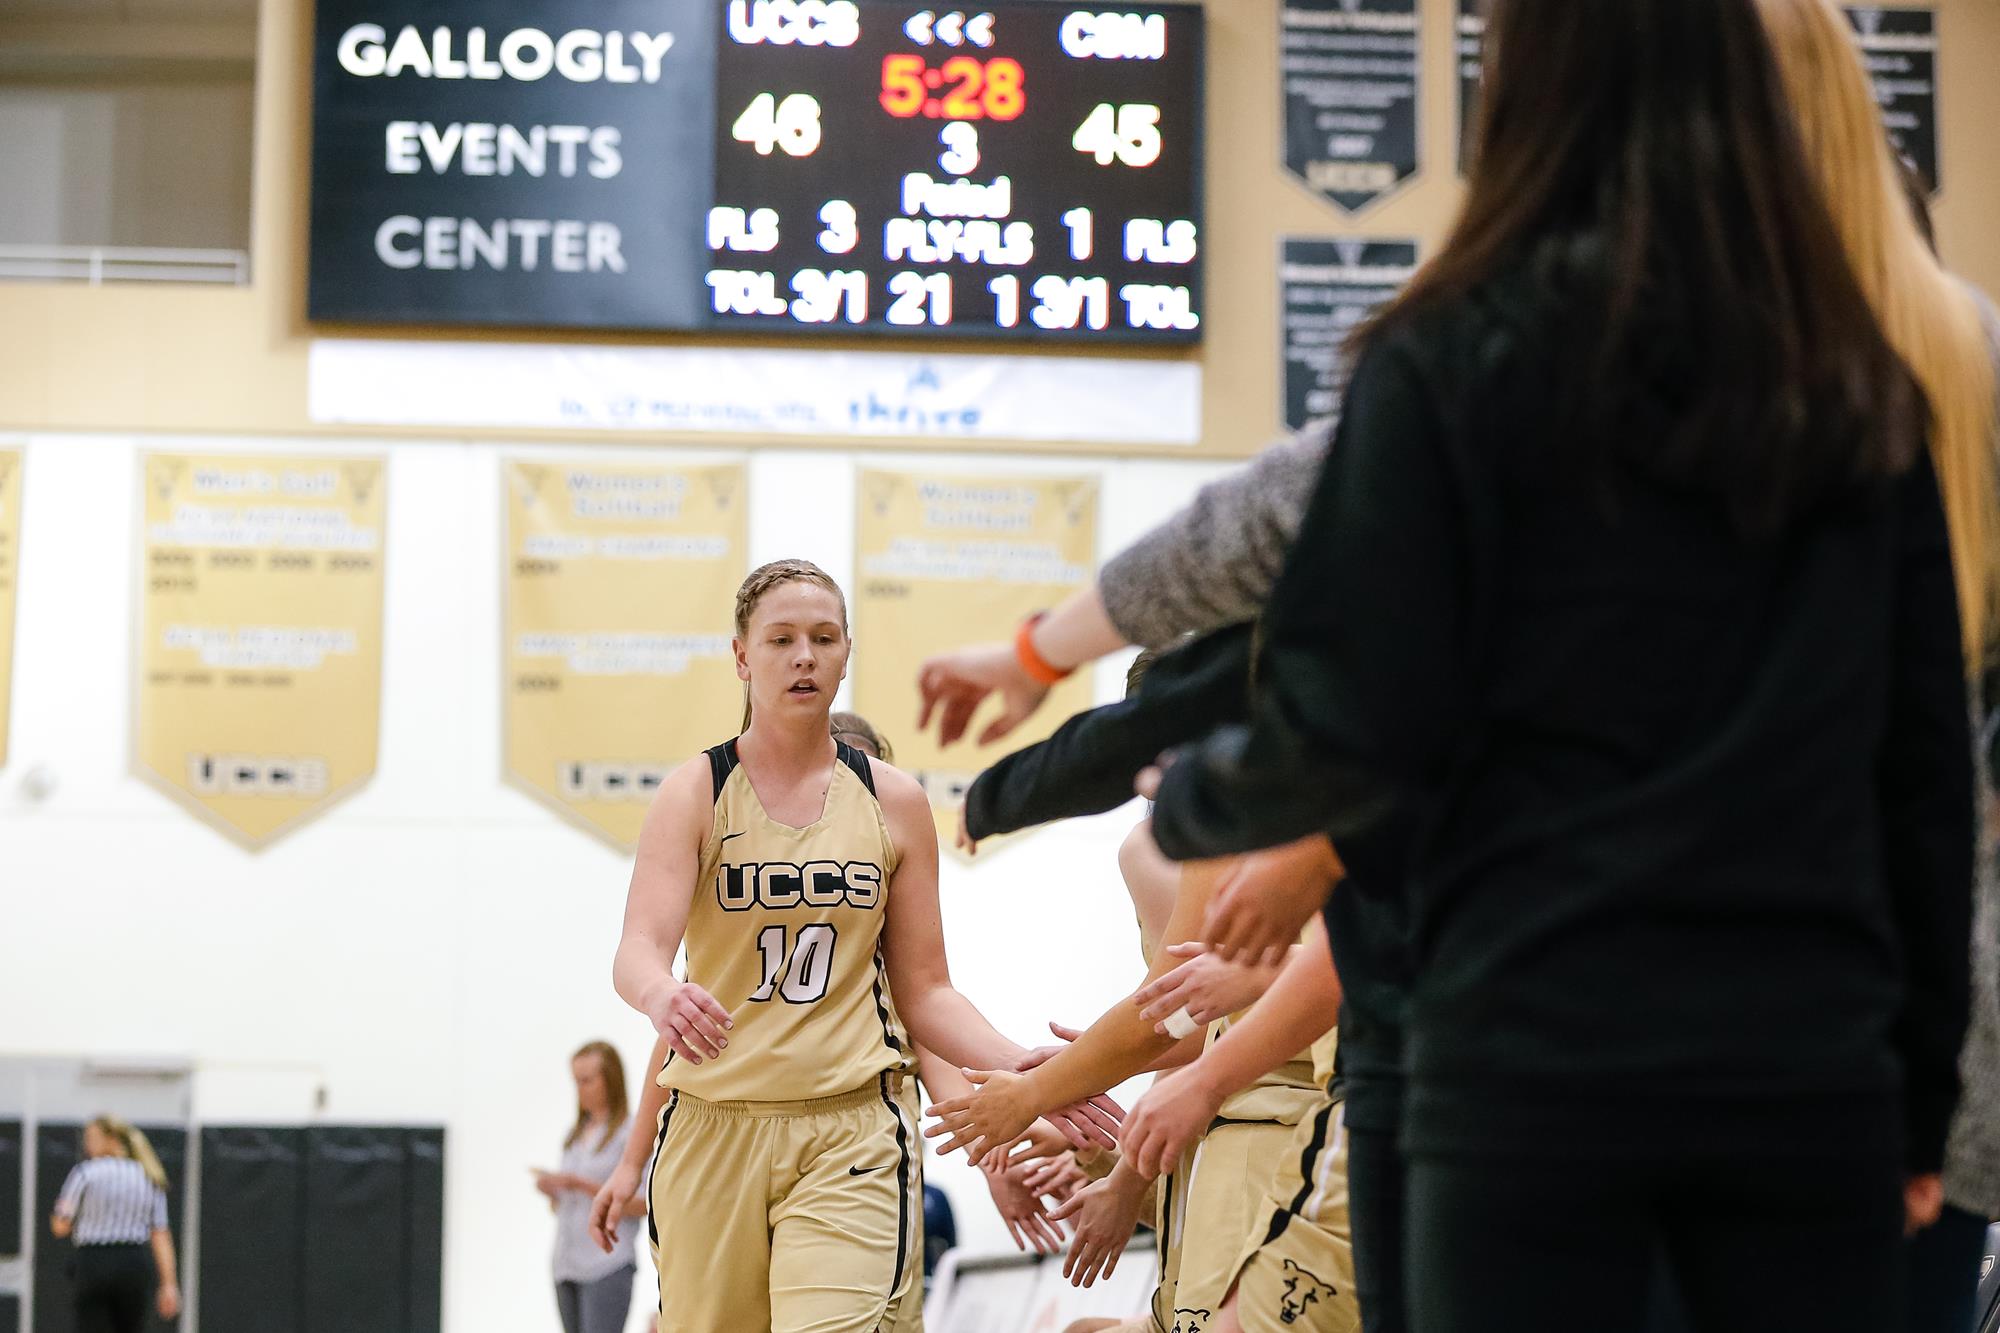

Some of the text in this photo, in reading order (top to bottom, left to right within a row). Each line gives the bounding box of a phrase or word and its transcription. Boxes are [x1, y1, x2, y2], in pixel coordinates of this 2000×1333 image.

[338, 23, 674, 83] GALLOGLY
[879, 54, 1026, 120] 5:28
[385, 120, 623, 178] EVENTS
[732, 92, 822, 156] 46
[938, 121, 979, 174] 3
[1073, 103, 1162, 166] 45
[375, 214, 627, 273] CENTER
[816, 199, 858, 254] 3
[1060, 207, 1093, 261] 1
[886, 270, 1020, 328] 21 1
[717, 861, 881, 912] UCCS
[747, 923, 838, 1004] 10
